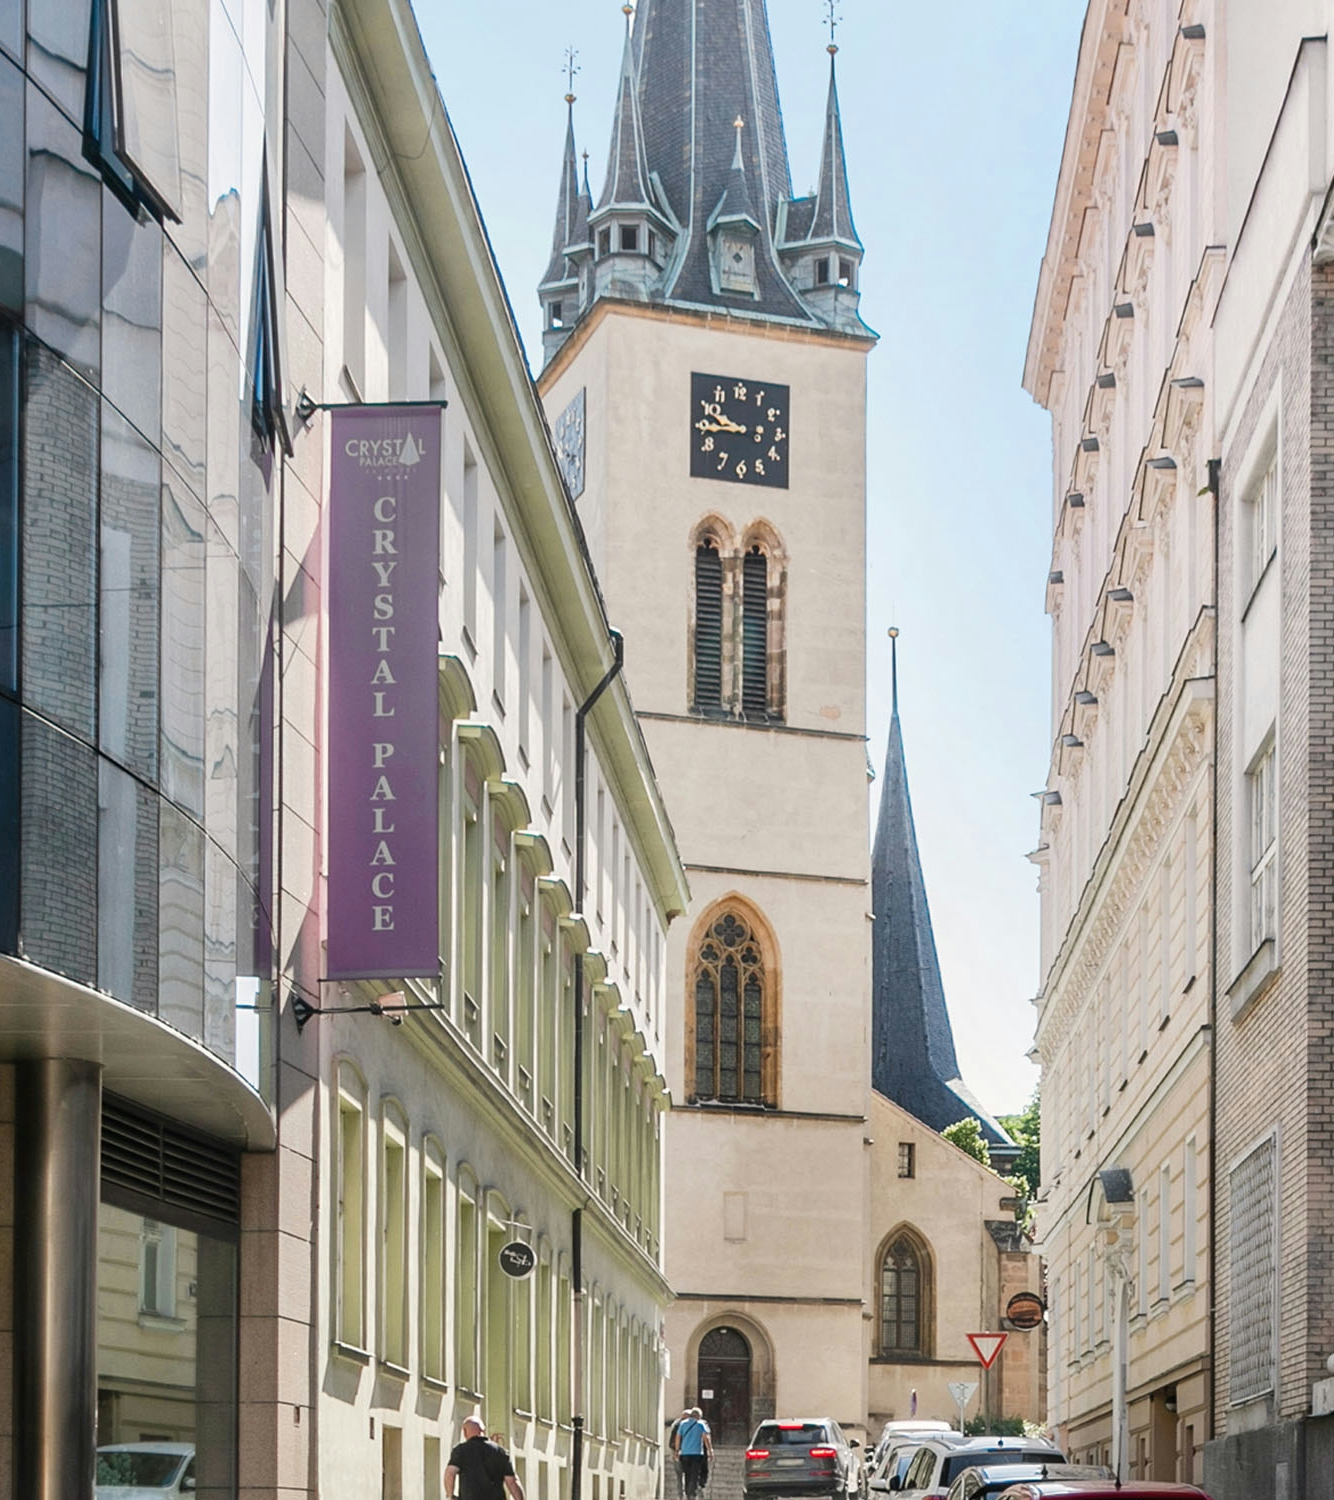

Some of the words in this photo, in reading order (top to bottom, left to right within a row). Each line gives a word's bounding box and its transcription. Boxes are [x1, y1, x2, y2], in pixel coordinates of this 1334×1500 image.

[714, 389, 725, 403] 11
[733, 385, 747, 401] 12
[703, 403, 721, 416] 10
[767, 408, 776, 422] 2
[774, 427, 783, 442] 3
[704, 437, 715, 452] 8
[359, 456, 398, 466] PALACE
[718, 451, 729, 467] 7
[768, 446, 778, 461] 4
[735, 460, 747, 476] 6
[755, 458, 764, 473] 5
[370, 496, 398, 717] CRYSTAL
[369, 743, 396, 932] PALACE
